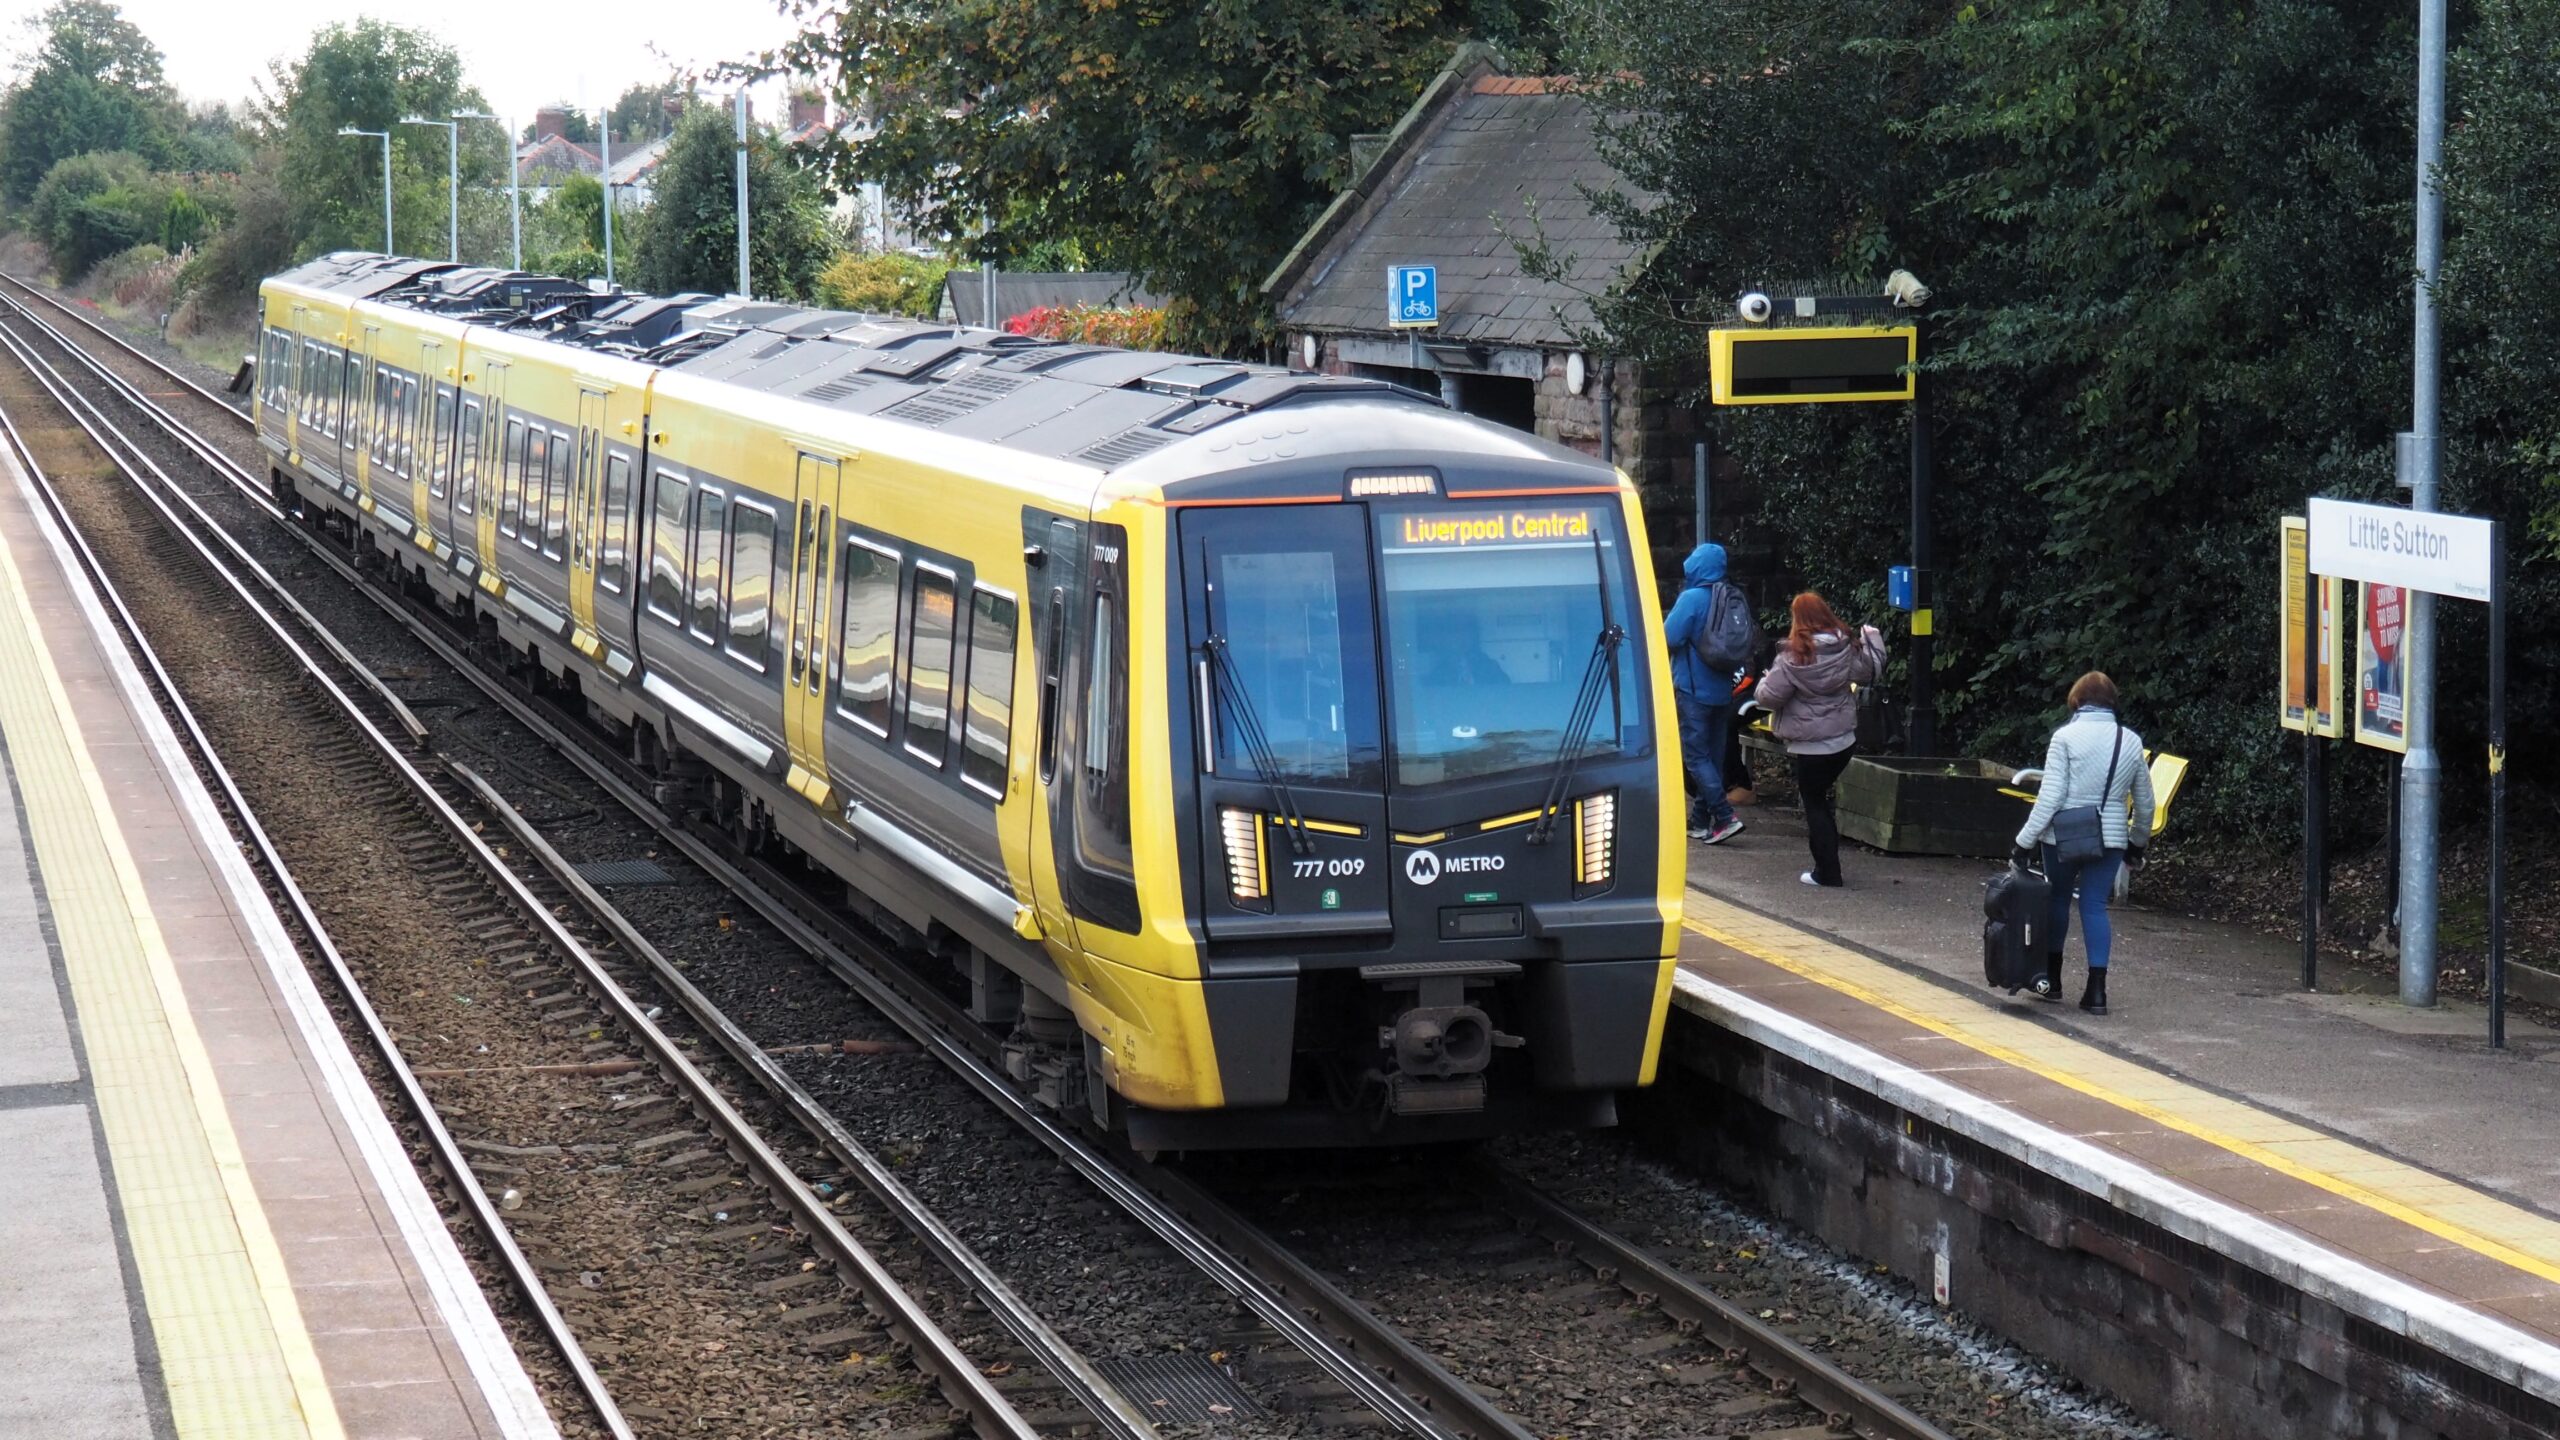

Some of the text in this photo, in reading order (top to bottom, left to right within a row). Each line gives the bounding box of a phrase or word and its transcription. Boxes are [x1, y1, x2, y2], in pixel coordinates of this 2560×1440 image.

[1407, 271, 1426, 297] P
[1405, 511, 1589, 545] Liverpool Central
[2349, 515, 2448, 561] Little Sutton
[1094, 545, 1119, 564] 777 009
[1293, 858, 1365, 878] 777 009
[1445, 856, 1505, 873] METRO
